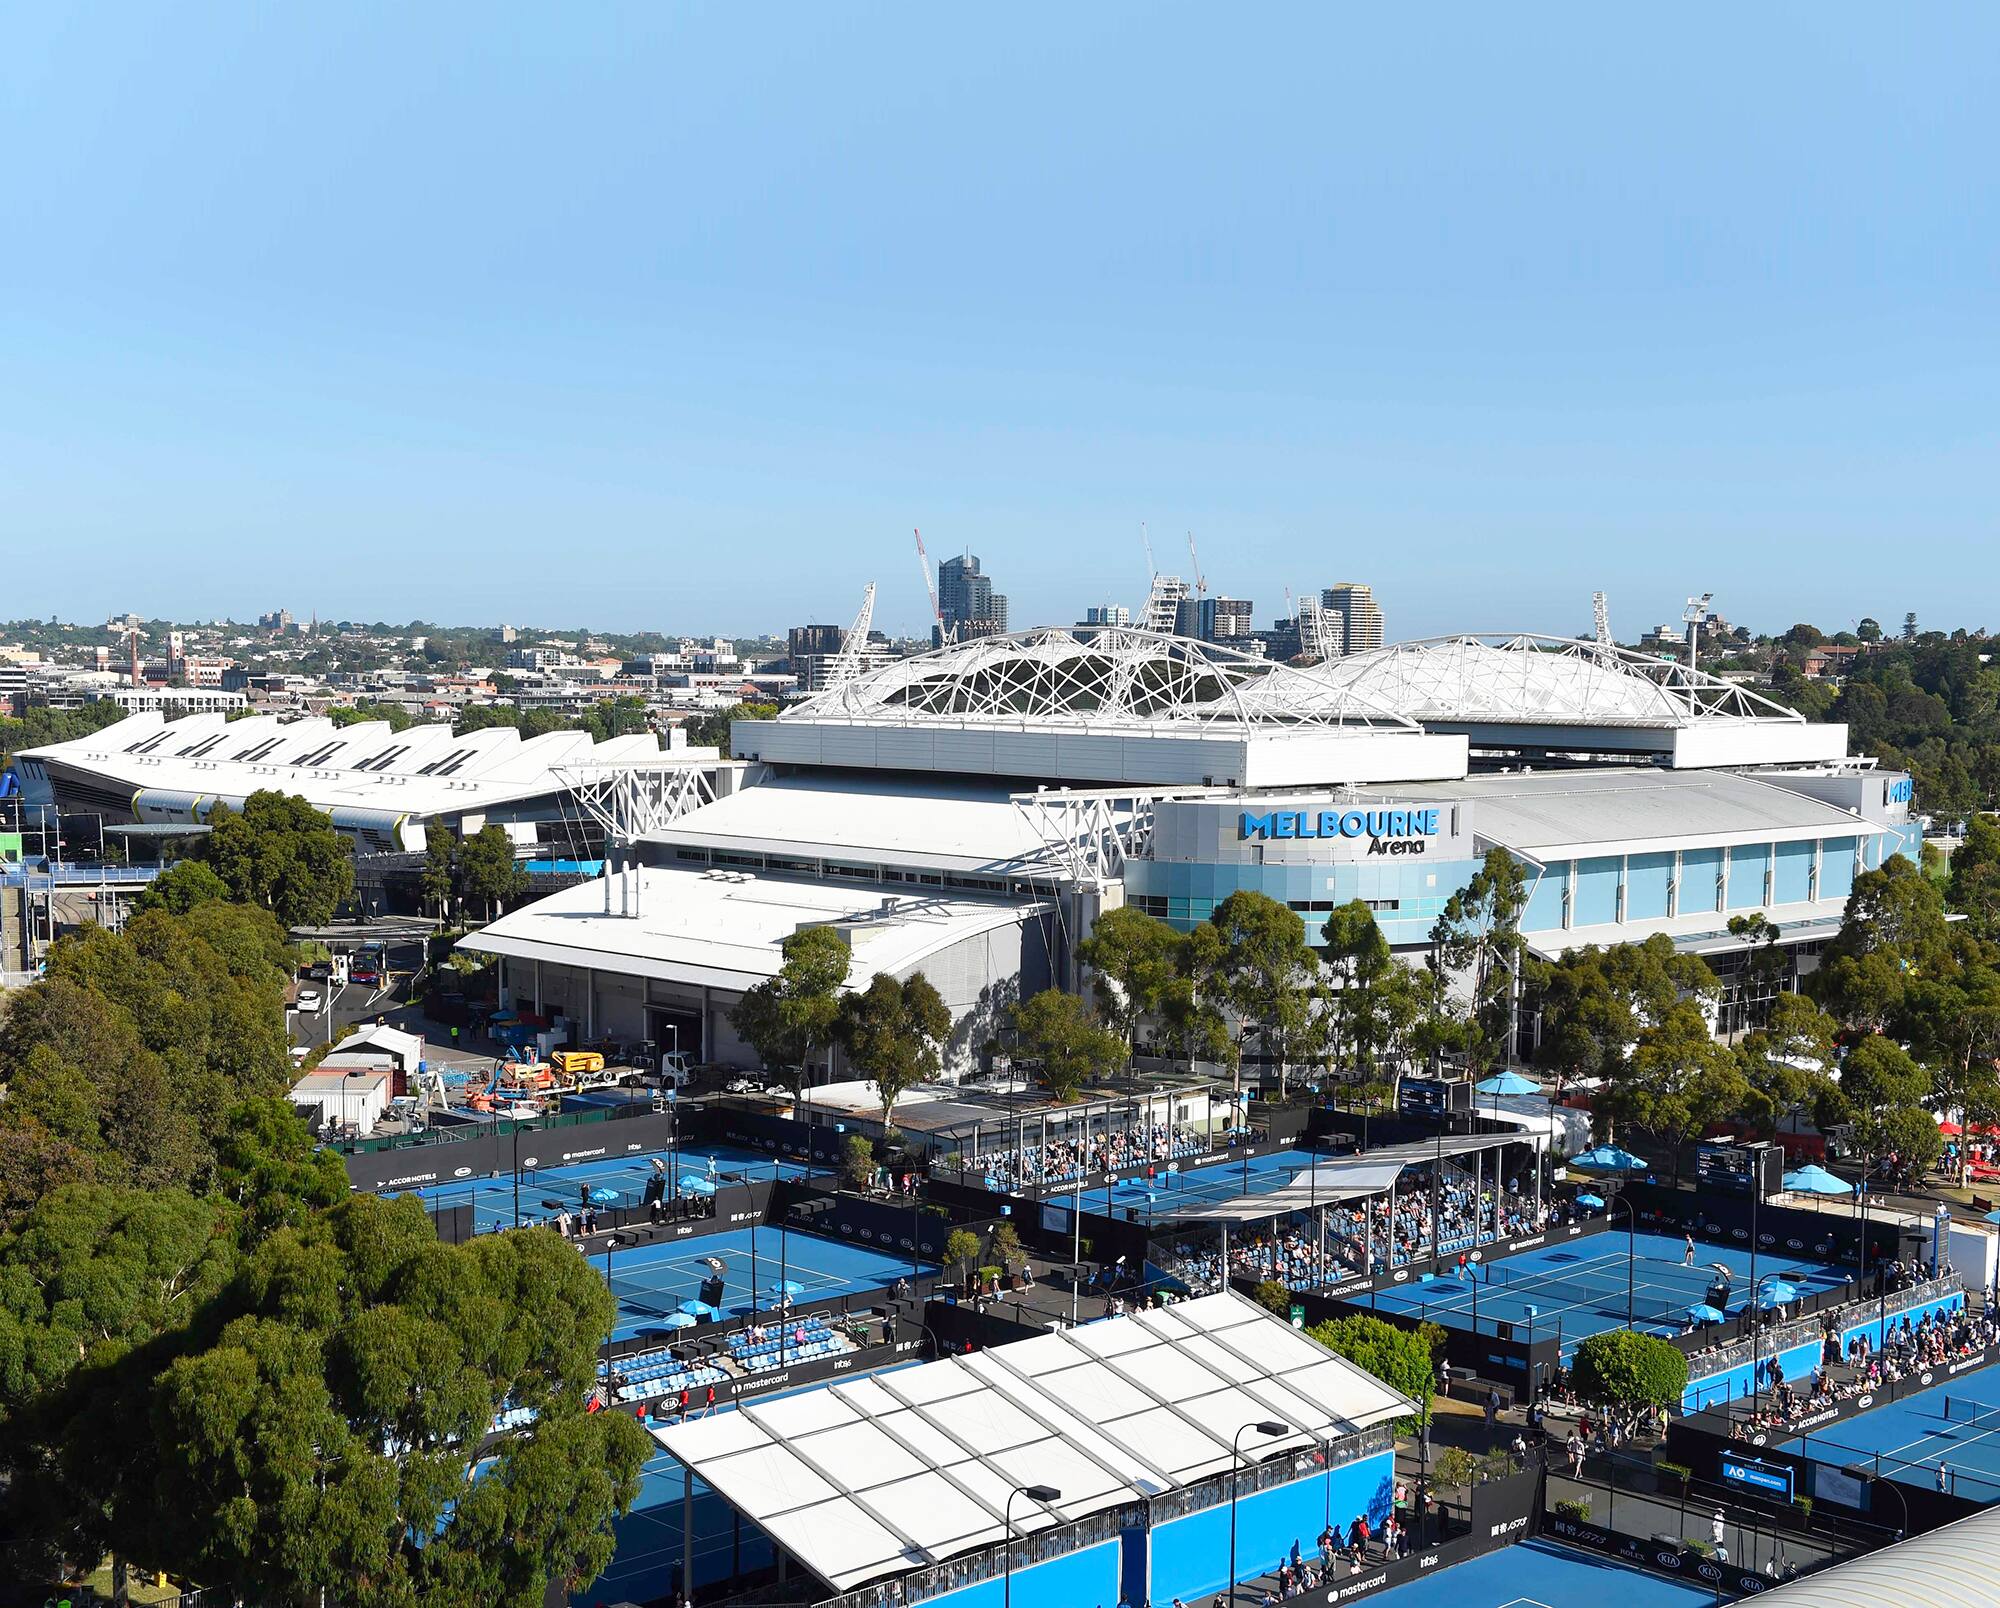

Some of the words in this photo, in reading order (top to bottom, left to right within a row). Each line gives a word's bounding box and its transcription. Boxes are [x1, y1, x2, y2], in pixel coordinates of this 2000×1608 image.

[1240, 808, 1440, 840] MELBOURNE
[1367, 838, 1425, 856] Arena
[571, 1147, 606, 1159] mastercard
[743, 1372, 789, 1391] mastercard
[1797, 1408, 1839, 1429] ACCORHOTELS
[1728, 1466, 1746, 1478] AO
[1620, 1548, 1645, 1560] ROLEX
[1339, 1572, 1386, 1598] mastercard
